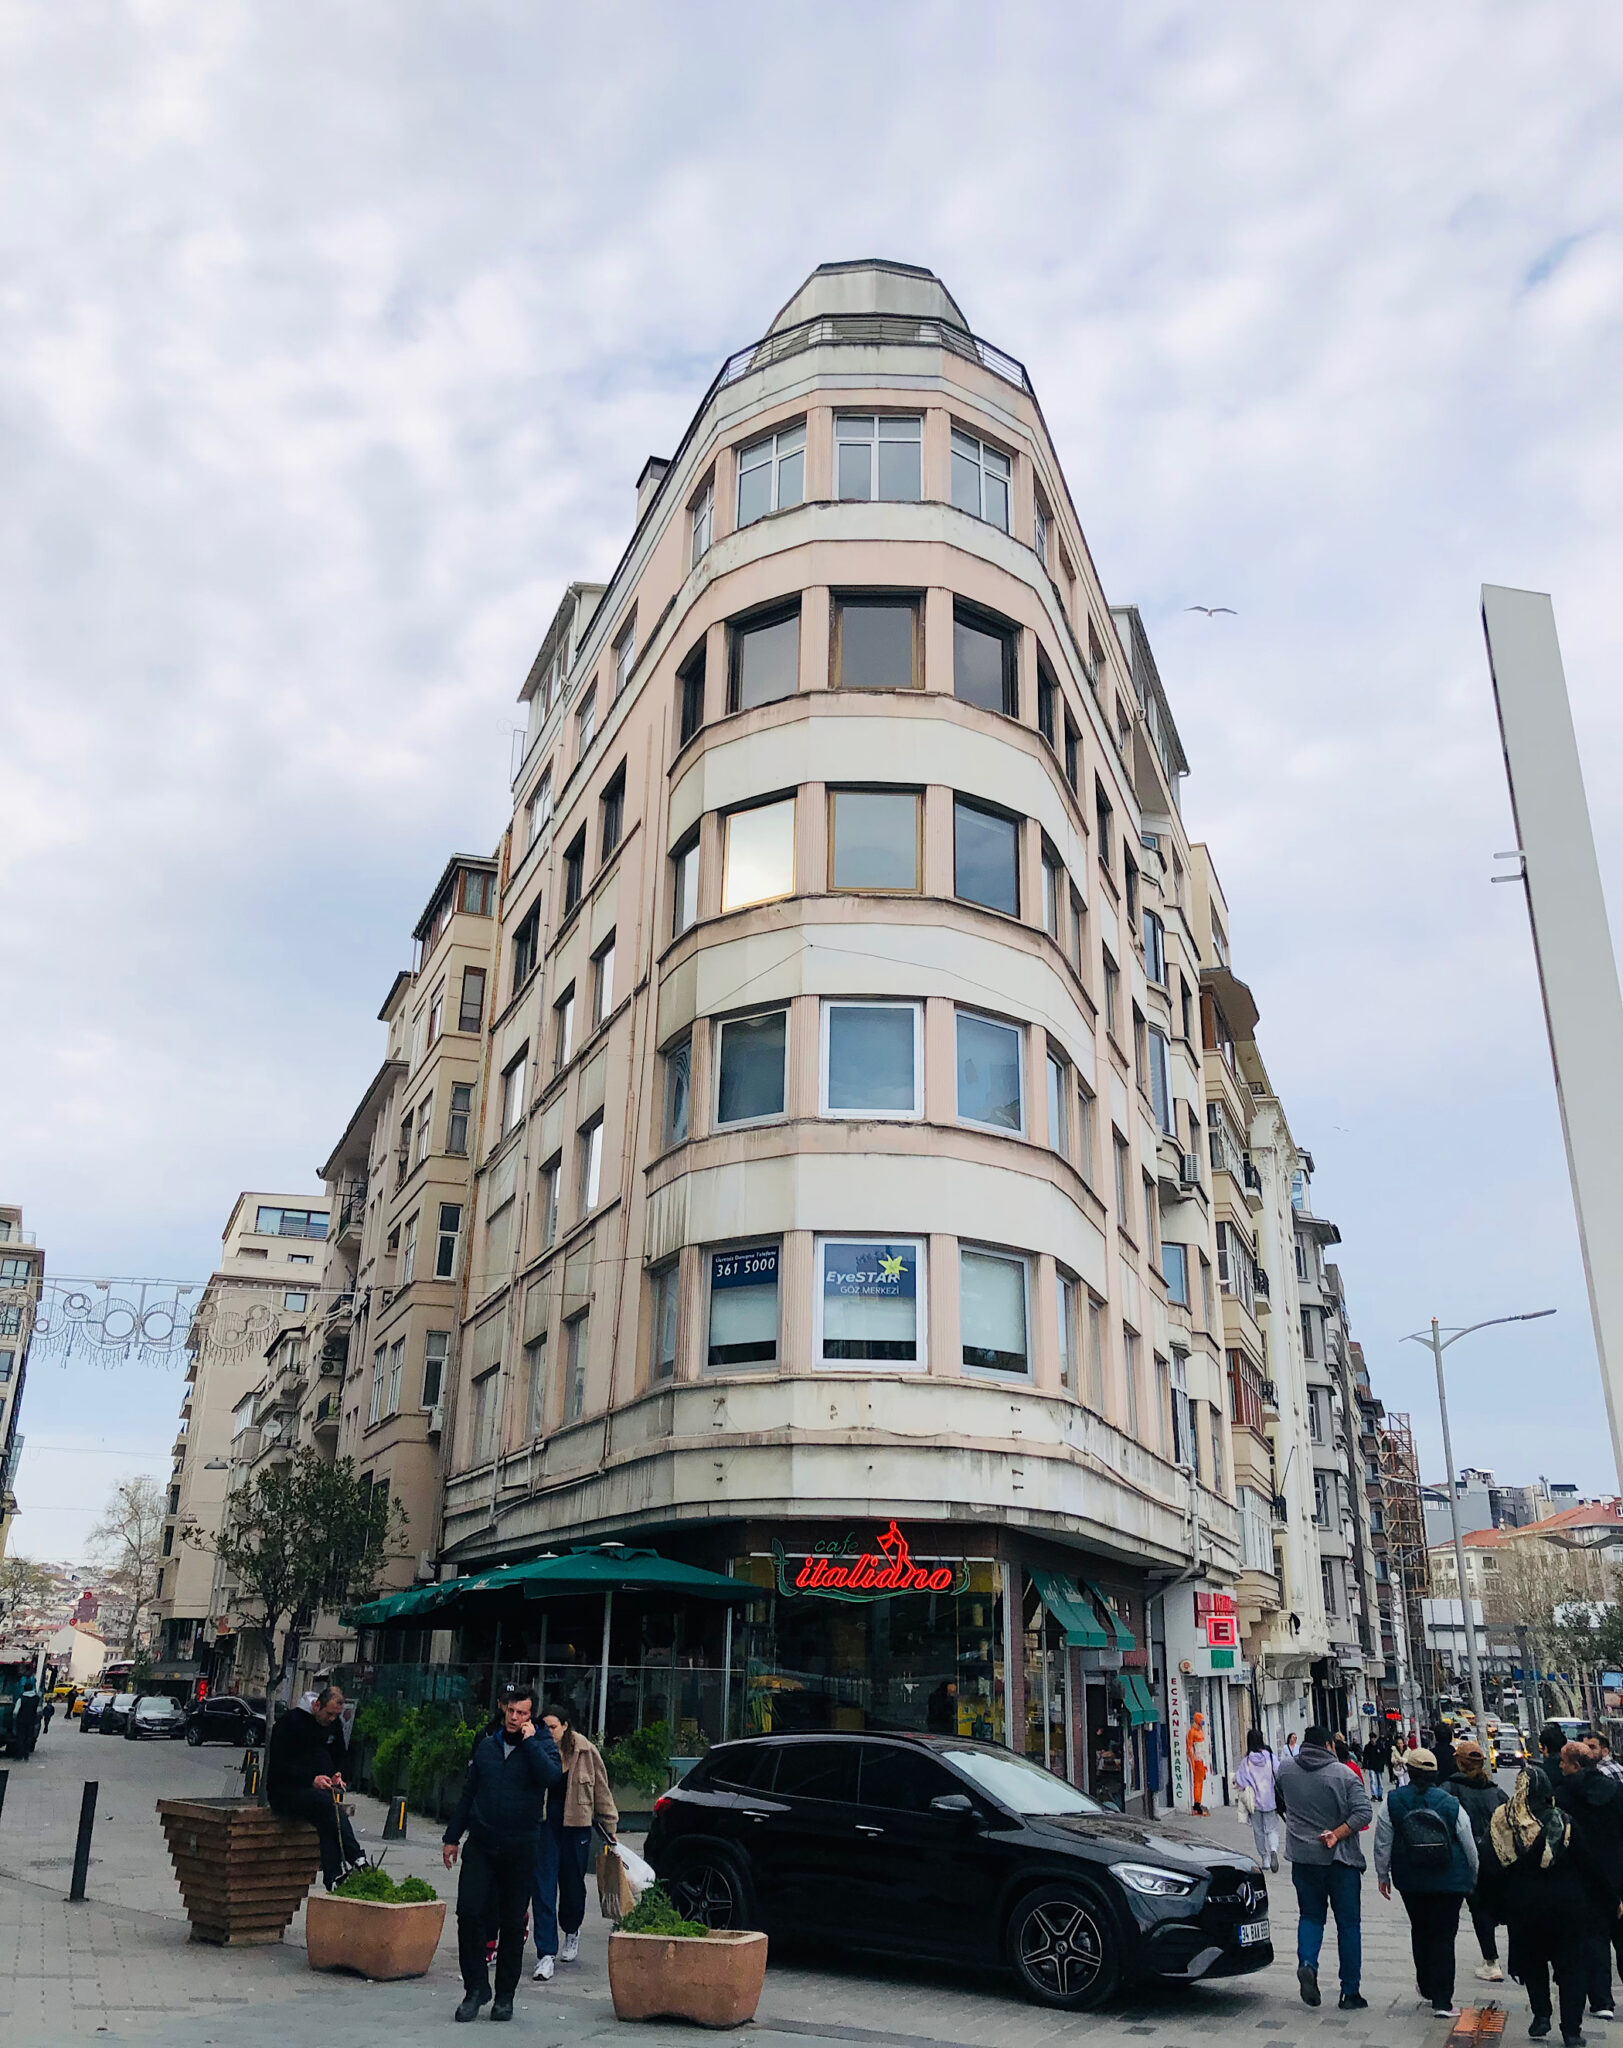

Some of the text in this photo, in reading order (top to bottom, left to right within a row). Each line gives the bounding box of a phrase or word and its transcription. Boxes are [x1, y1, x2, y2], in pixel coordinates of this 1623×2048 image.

[716, 1257, 775, 1277] 361 5000
[826, 1271, 899, 1284] EyeSTAR
[840, 1284, 899, 1295] GÖZ MERKEZİ
[814, 1531, 859, 1555] cafe
[795, 1553, 952, 1590] italiano
[1214, 1622, 1229, 1641] E
